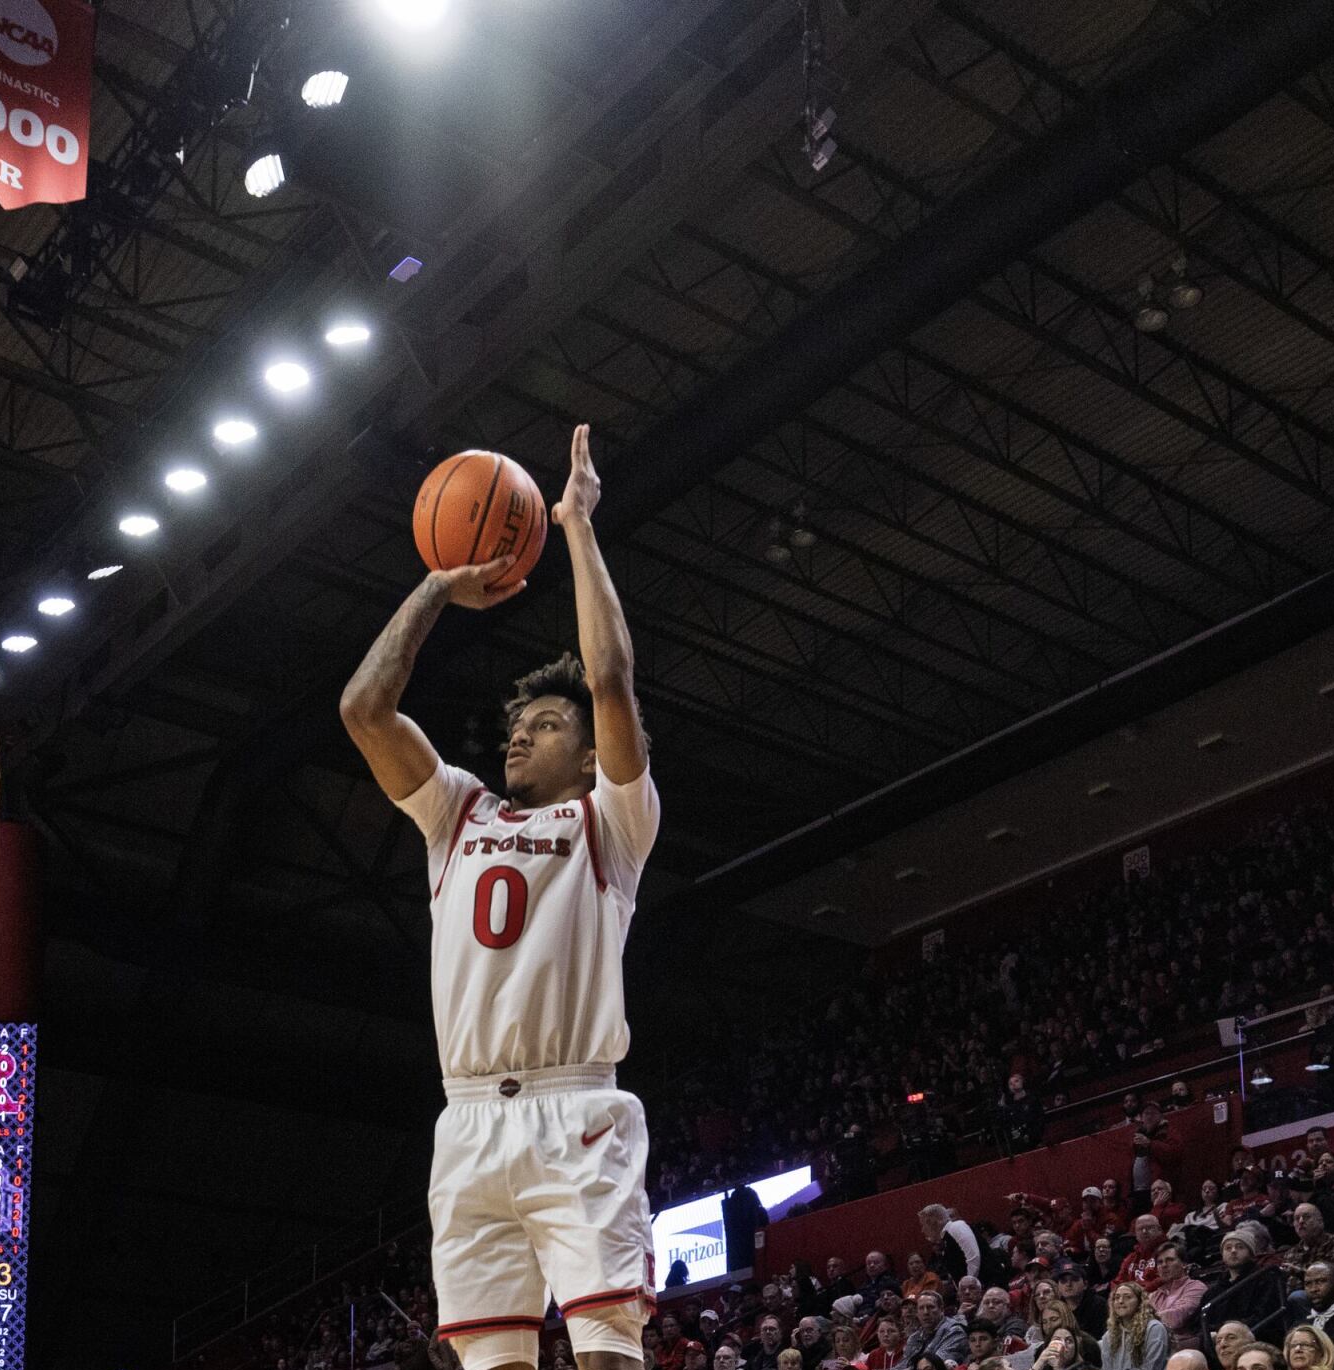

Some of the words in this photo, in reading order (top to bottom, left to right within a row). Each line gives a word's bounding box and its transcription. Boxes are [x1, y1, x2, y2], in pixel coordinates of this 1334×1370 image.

[463, 836, 571, 857] UTGERS
[473, 865, 528, 949] 0
[0, 1028, 9, 1038] A
[21, 1028, 29, 1038] F
[1, 1044, 9, 1054] 2
[0, 1062, 8, 1072] 0
[0, 1078, 7, 1088] 0
[0, 1094, 7, 1104] 0
[17, 1145, 25, 1154] F
[668, 1239, 725, 1266] Horizon
